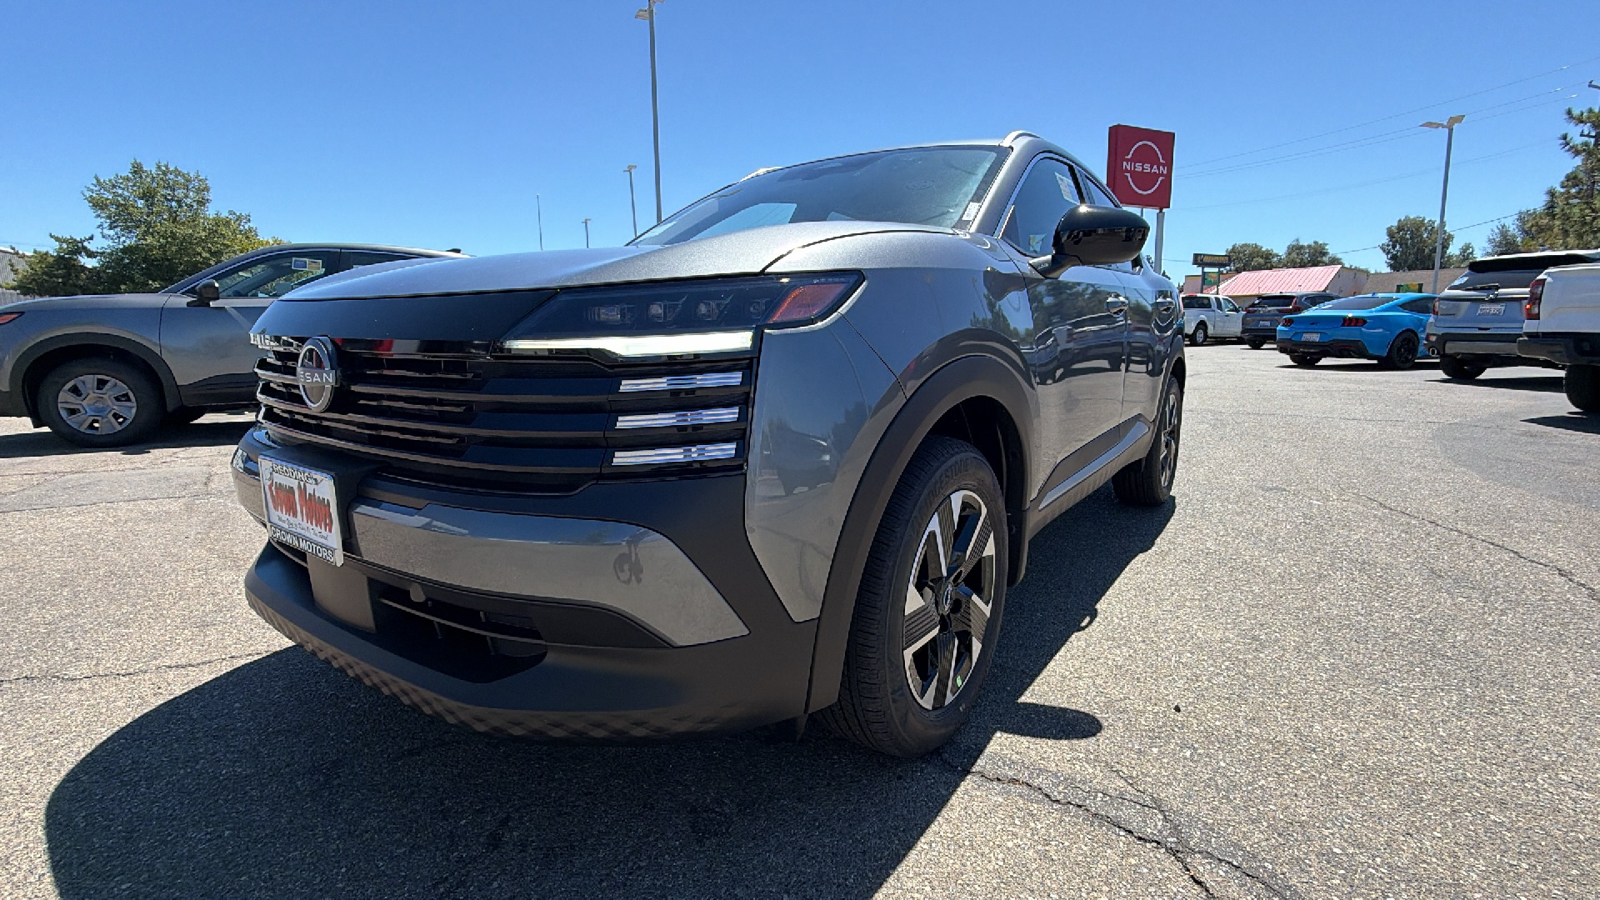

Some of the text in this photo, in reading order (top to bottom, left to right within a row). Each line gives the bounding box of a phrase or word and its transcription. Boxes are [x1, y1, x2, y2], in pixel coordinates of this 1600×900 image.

[1123, 161, 1167, 175] NISSAN
[299, 371, 333, 383] SSAN
[297, 480, 333, 533] Motors
[271, 526, 299, 548] CROWN
[299, 537, 334, 562] MOTORS
